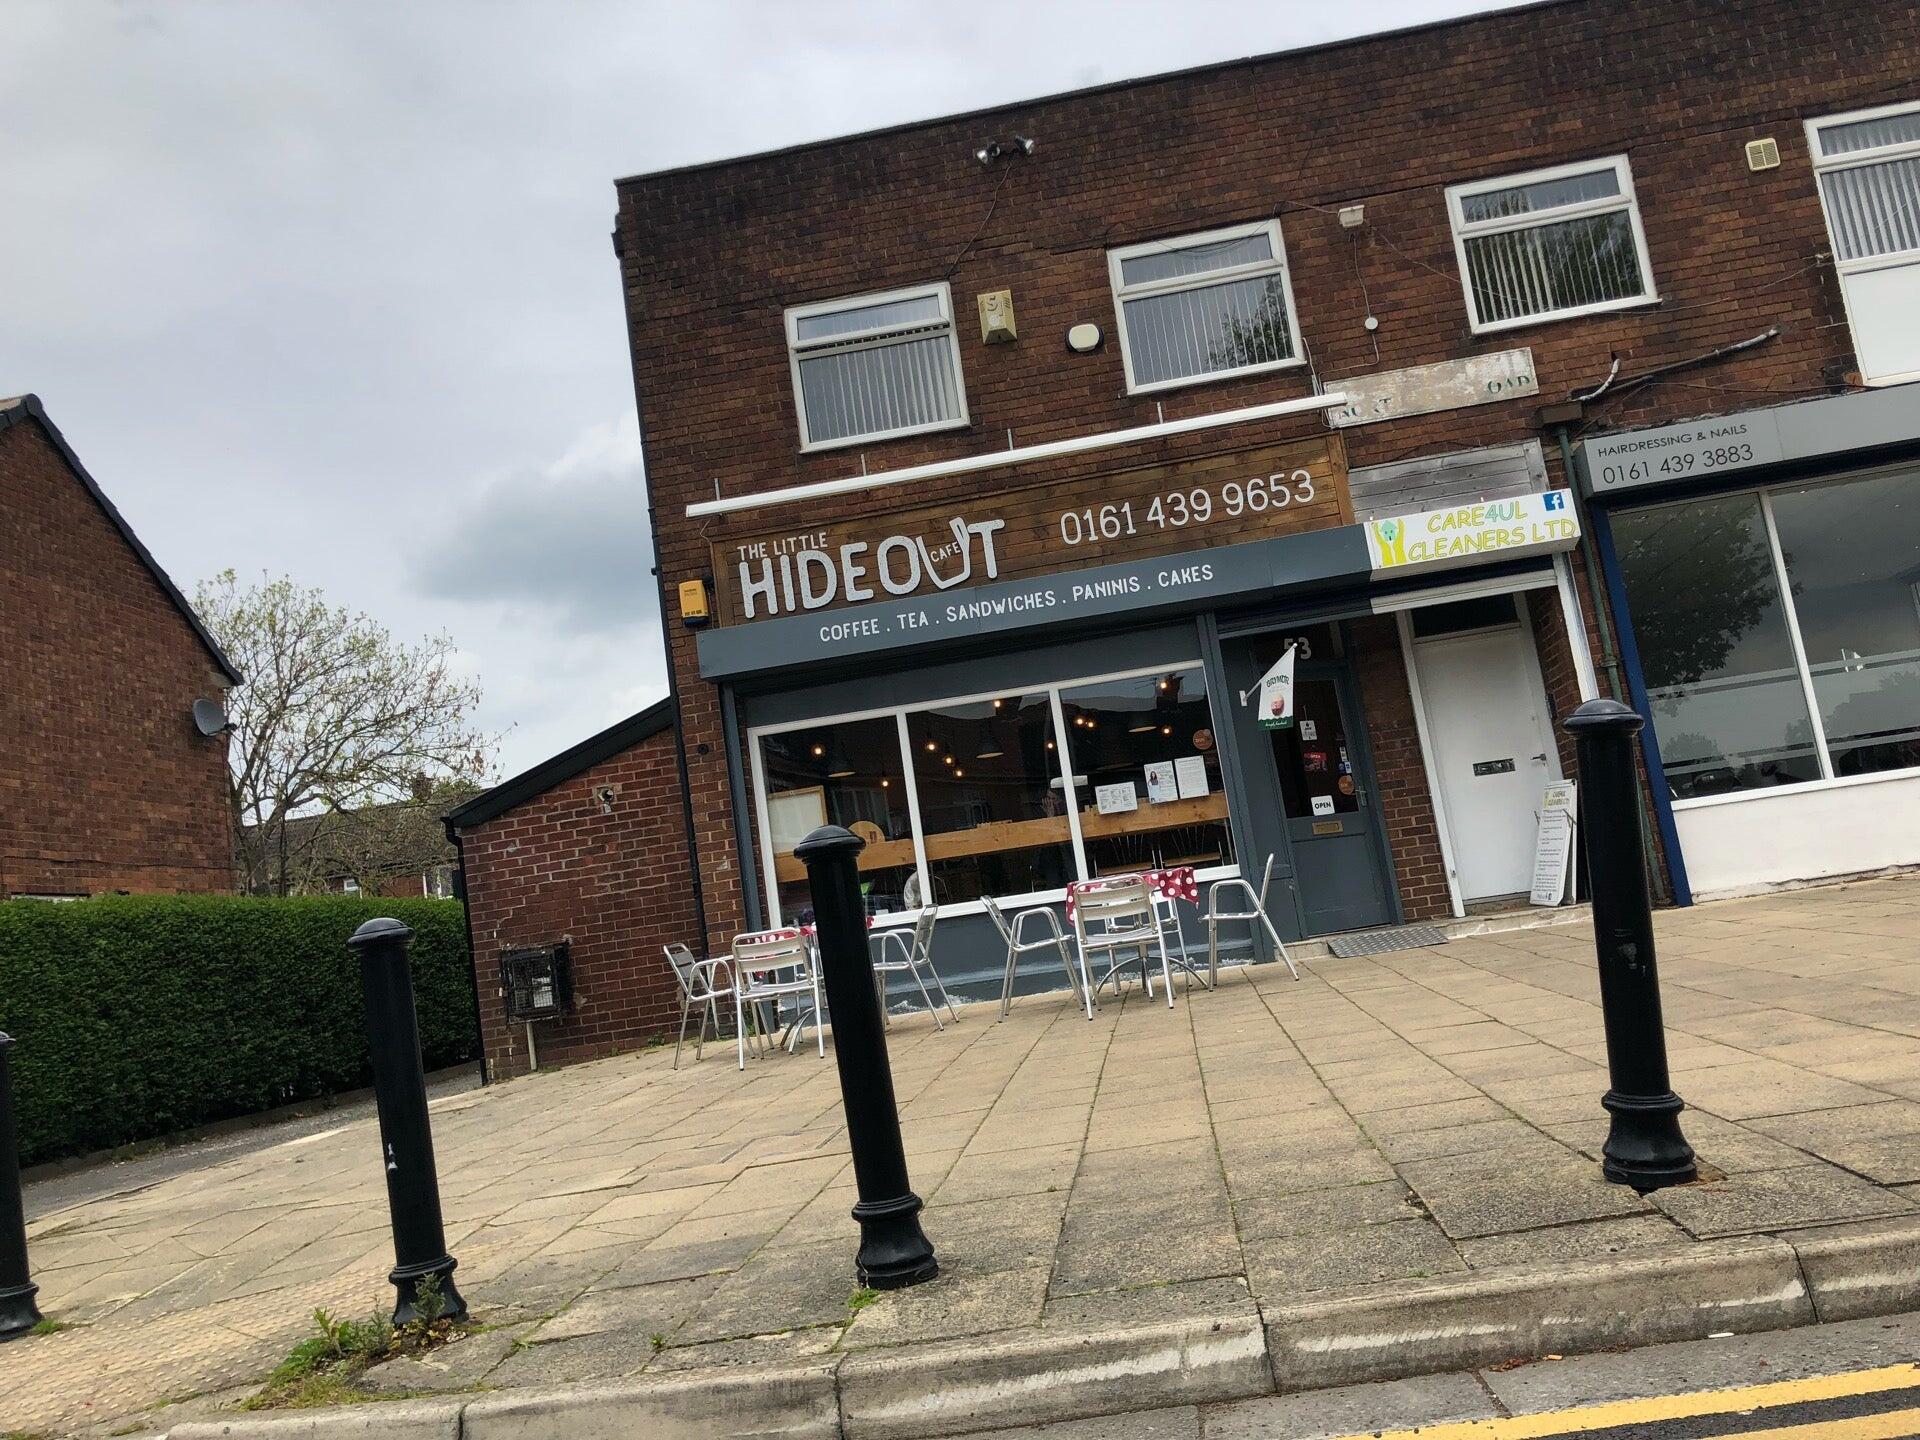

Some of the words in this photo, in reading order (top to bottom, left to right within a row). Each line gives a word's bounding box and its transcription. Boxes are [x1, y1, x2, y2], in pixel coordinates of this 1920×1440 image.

[1598, 433, 1692, 458] HAIRDRESSING
[1697, 431, 1707, 441] &
[1710, 424, 1748, 439] NAILS
[1602, 461, 1650, 485] 0161
[1659, 453, 1695, 474] 439
[1702, 443, 1754, 468] 3883
[1060, 502, 1137, 545] 0161
[1146, 488, 1212, 529] 439
[1221, 469, 1315, 516] 9653
[1427, 500, 1528, 533] CARE4UL
[737, 542, 768, 561] THE
[773, 532, 828, 556] LITTLE
[1408, 526, 1525, 561] CLEANERS
[1531, 519, 1577, 542] LTD
[739, 515, 1006, 619] HIDEOUT
[820, 618, 880, 642] COFFEE
[897, 611, 929, 630] TEA
[946, 590, 1056, 623] SANDWICHES
[1073, 577, 1141, 602] PANINIS
[1157, 564, 1214, 588] CAKES
[1314, 801, 1331, 809] OPEN
